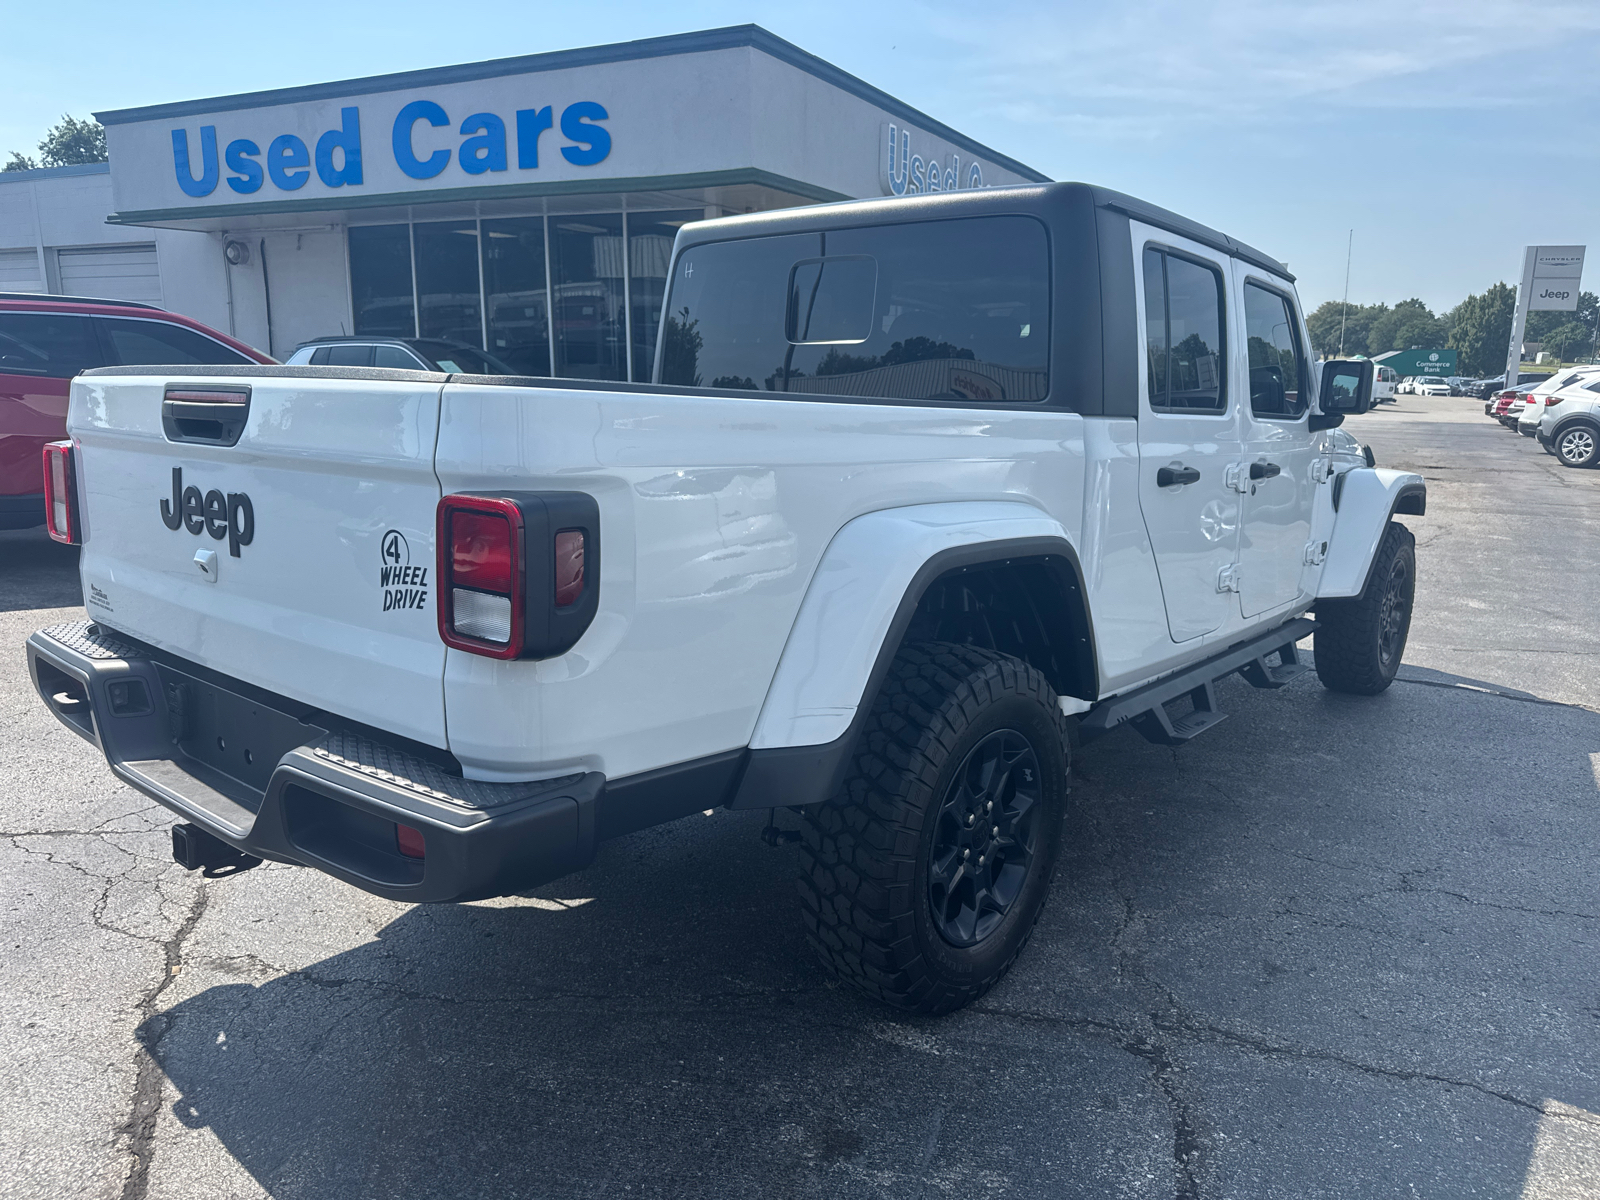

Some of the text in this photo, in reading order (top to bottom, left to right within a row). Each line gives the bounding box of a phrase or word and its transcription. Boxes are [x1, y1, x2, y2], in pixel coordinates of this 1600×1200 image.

[171, 100, 612, 198] Used Cars
[888, 123, 960, 197] Used
[685, 262, 694, 278] H
[1539, 289, 1570, 300] Jeep
[159, 465, 255, 558] Jeep
[385, 535, 401, 564] 4
[380, 565, 428, 588] WHEEL
[382, 588, 428, 612] DRIVE
